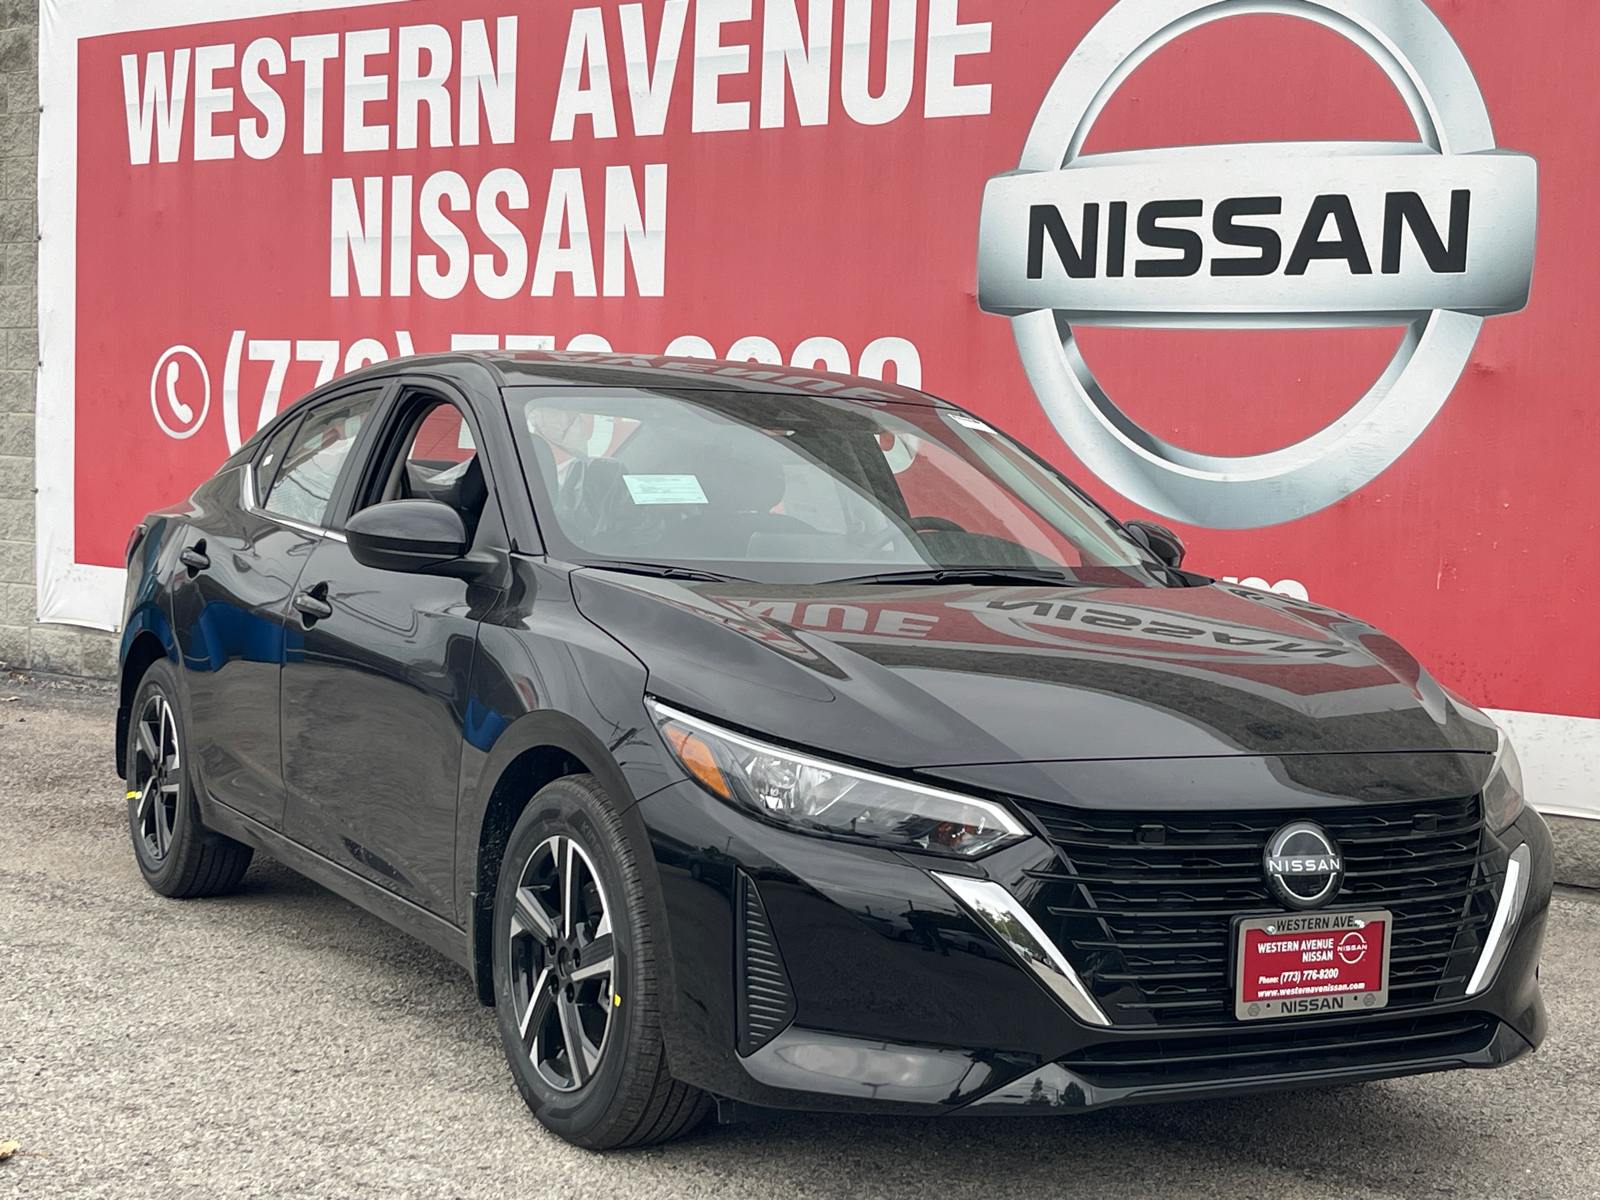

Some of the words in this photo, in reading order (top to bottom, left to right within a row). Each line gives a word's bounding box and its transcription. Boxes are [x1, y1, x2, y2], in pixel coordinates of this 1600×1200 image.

[121, 15, 518, 165] WESTERN
[550, 0, 993, 141] AVENUE
[330, 164, 668, 299] NISSAN
[1026, 189, 1471, 279] NISSAN
[1269, 858, 1340, 872] NISSAN
[1276, 919, 1329, 932] WESTERN
[1257, 941, 1299, 954] WESTERN
[1300, 938, 1334, 951] AVENUE
[1337, 944, 1368, 952] NISSAN
[1302, 950, 1333, 963] NISSAN
[1258, 976, 1279, 985] Phone:
[1280, 971, 1301, 985] (773)
[1302, 968, 1339, 981] 776-8200
[1257, 982, 1366, 998] www.westernavenissan.com
[1280, 996, 1344, 1014] NISSAN
